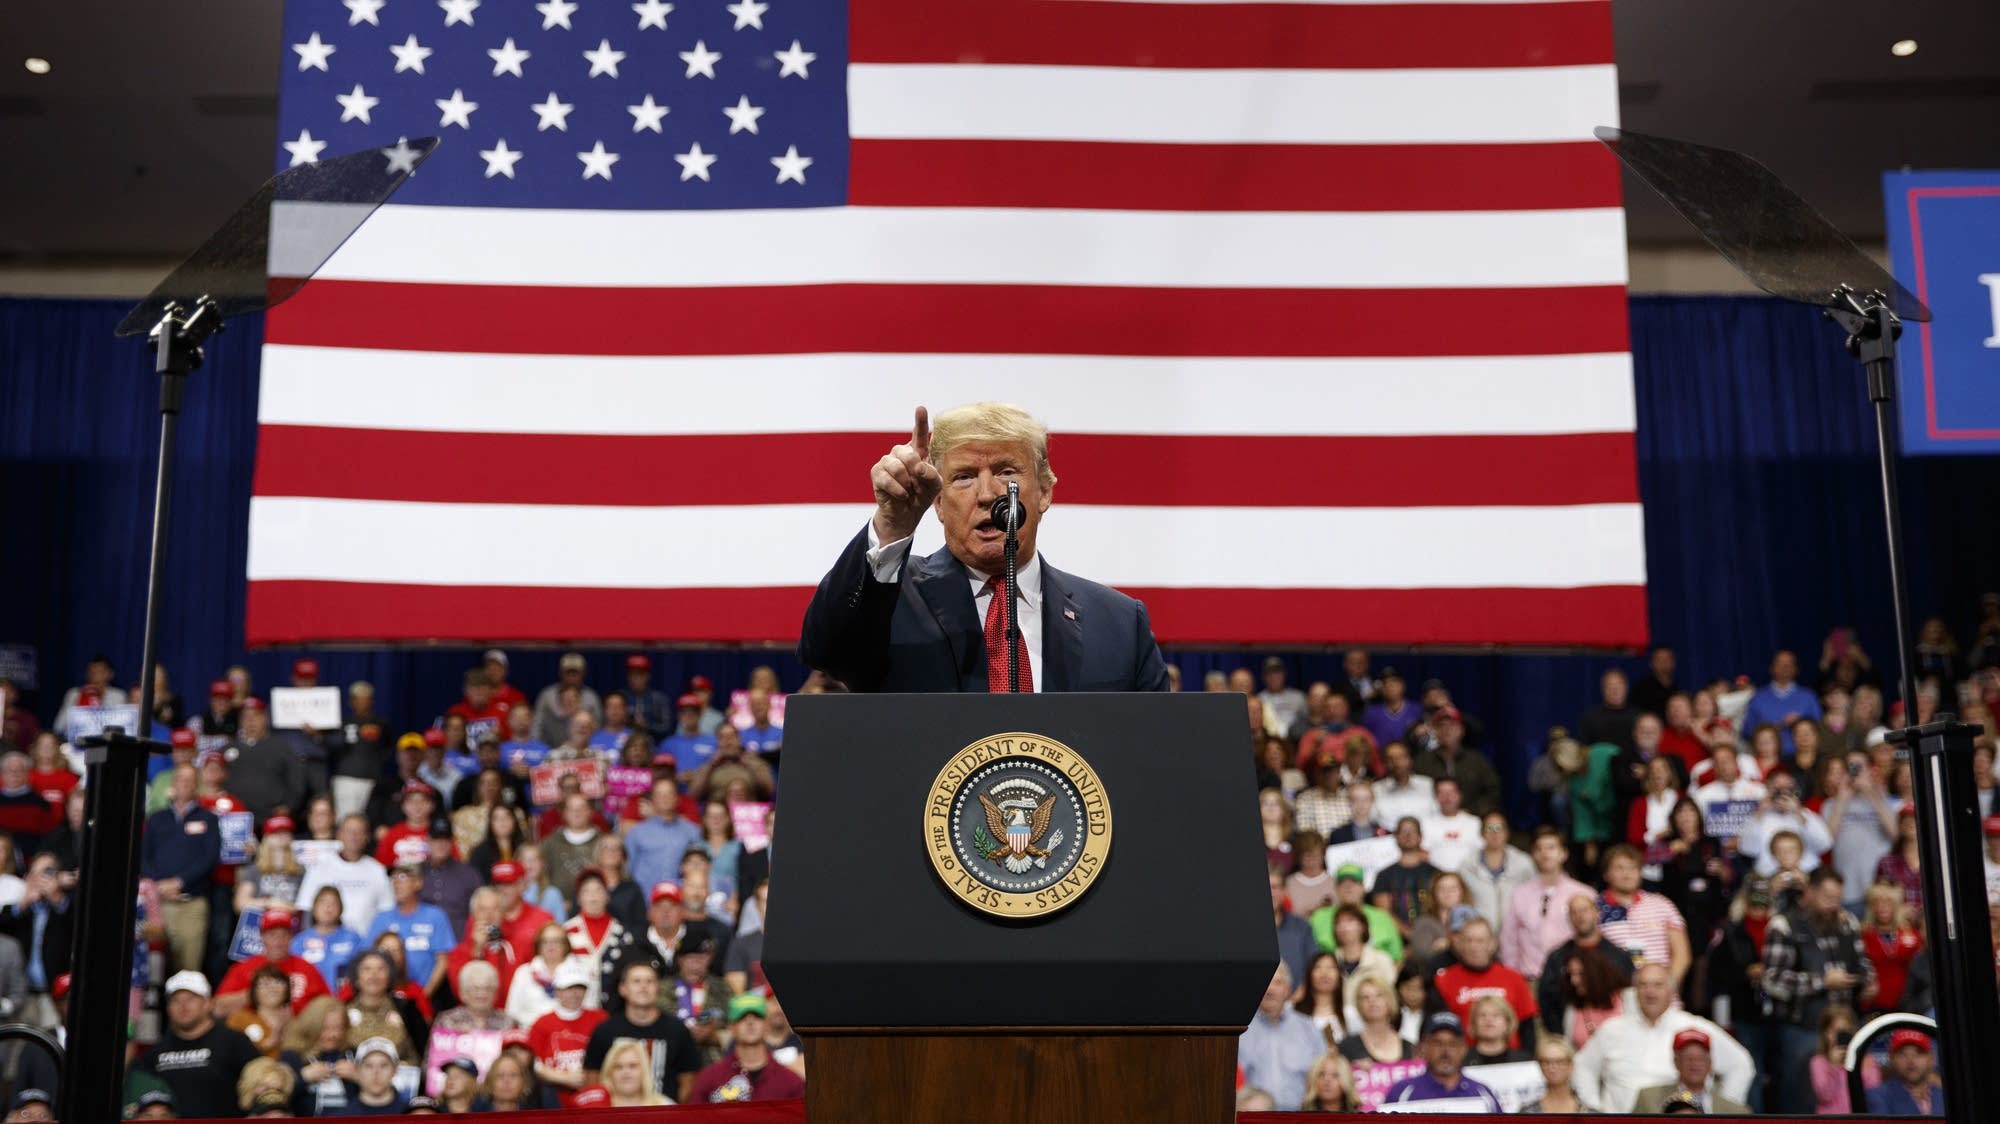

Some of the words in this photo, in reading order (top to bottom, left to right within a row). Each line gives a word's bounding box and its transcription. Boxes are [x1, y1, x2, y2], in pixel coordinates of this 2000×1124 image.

[1019, 742, 1037, 753] OF
[1041, 745, 1063, 763] THE
[932, 739, 1014, 819] PRESIDENT
[1067, 761, 1106, 836] UNITED
[933, 825, 946, 851] THE
[940, 853, 955, 870] OF
[954, 869, 1001, 908] SEAL
[1036, 852, 1098, 908] STATES
